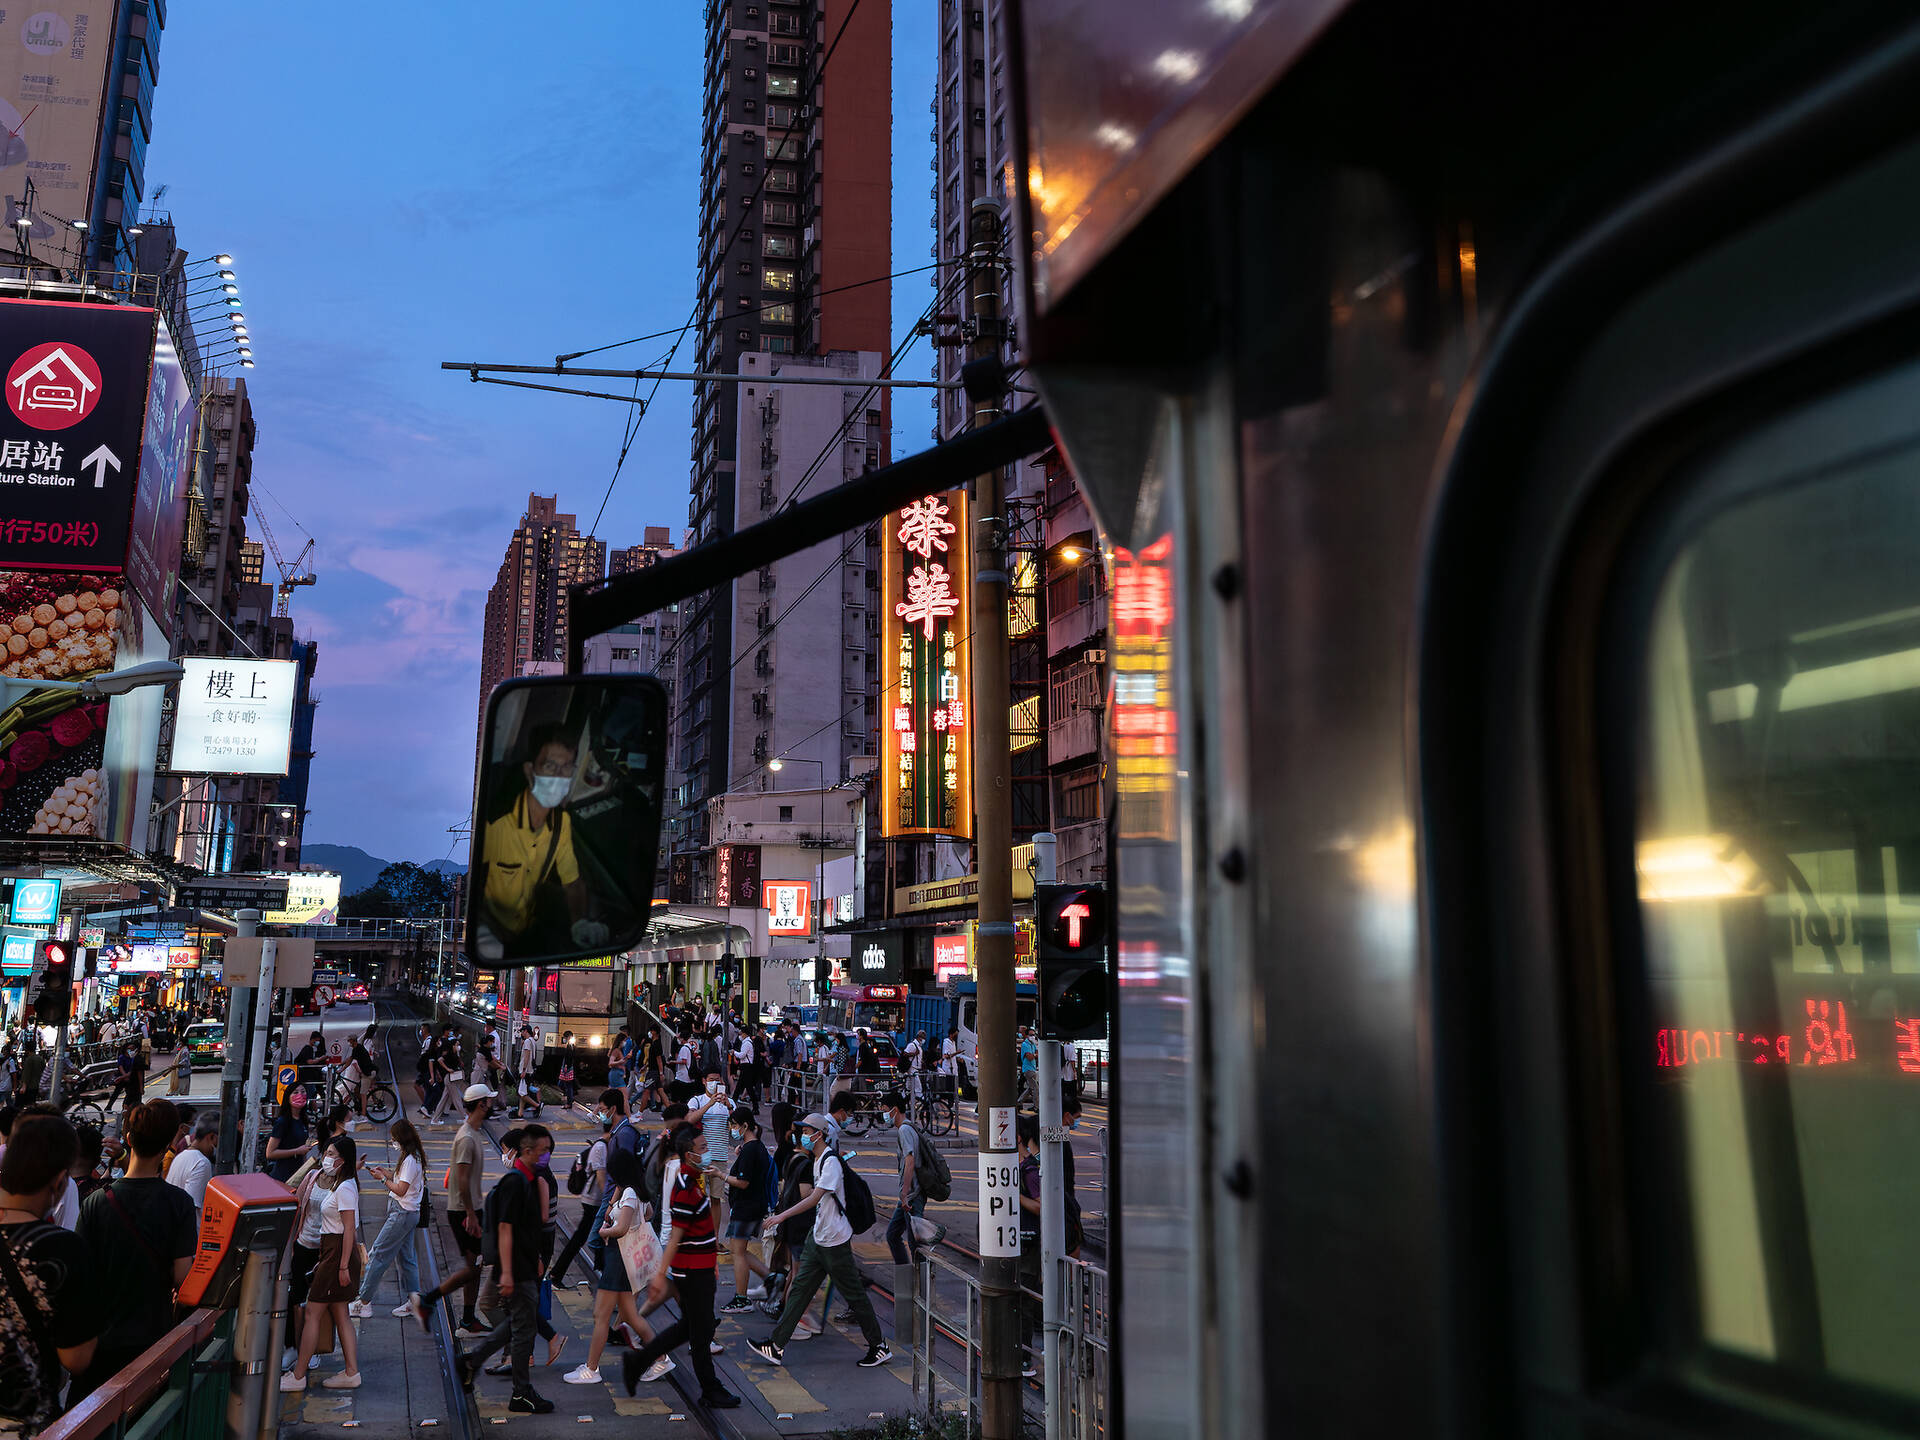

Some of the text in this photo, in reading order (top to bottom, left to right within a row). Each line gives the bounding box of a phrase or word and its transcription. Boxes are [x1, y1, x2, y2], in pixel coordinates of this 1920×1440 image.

[28, 473, 75, 487] Station
[896, 494, 960, 642] 榮華
[206, 670, 267, 699] 樓上
[775, 918, 798, 927] KFC
[862, 944, 886, 969] adidas
[987, 1166, 1019, 1188] 590
[997, 1226, 1017, 1247] 13
